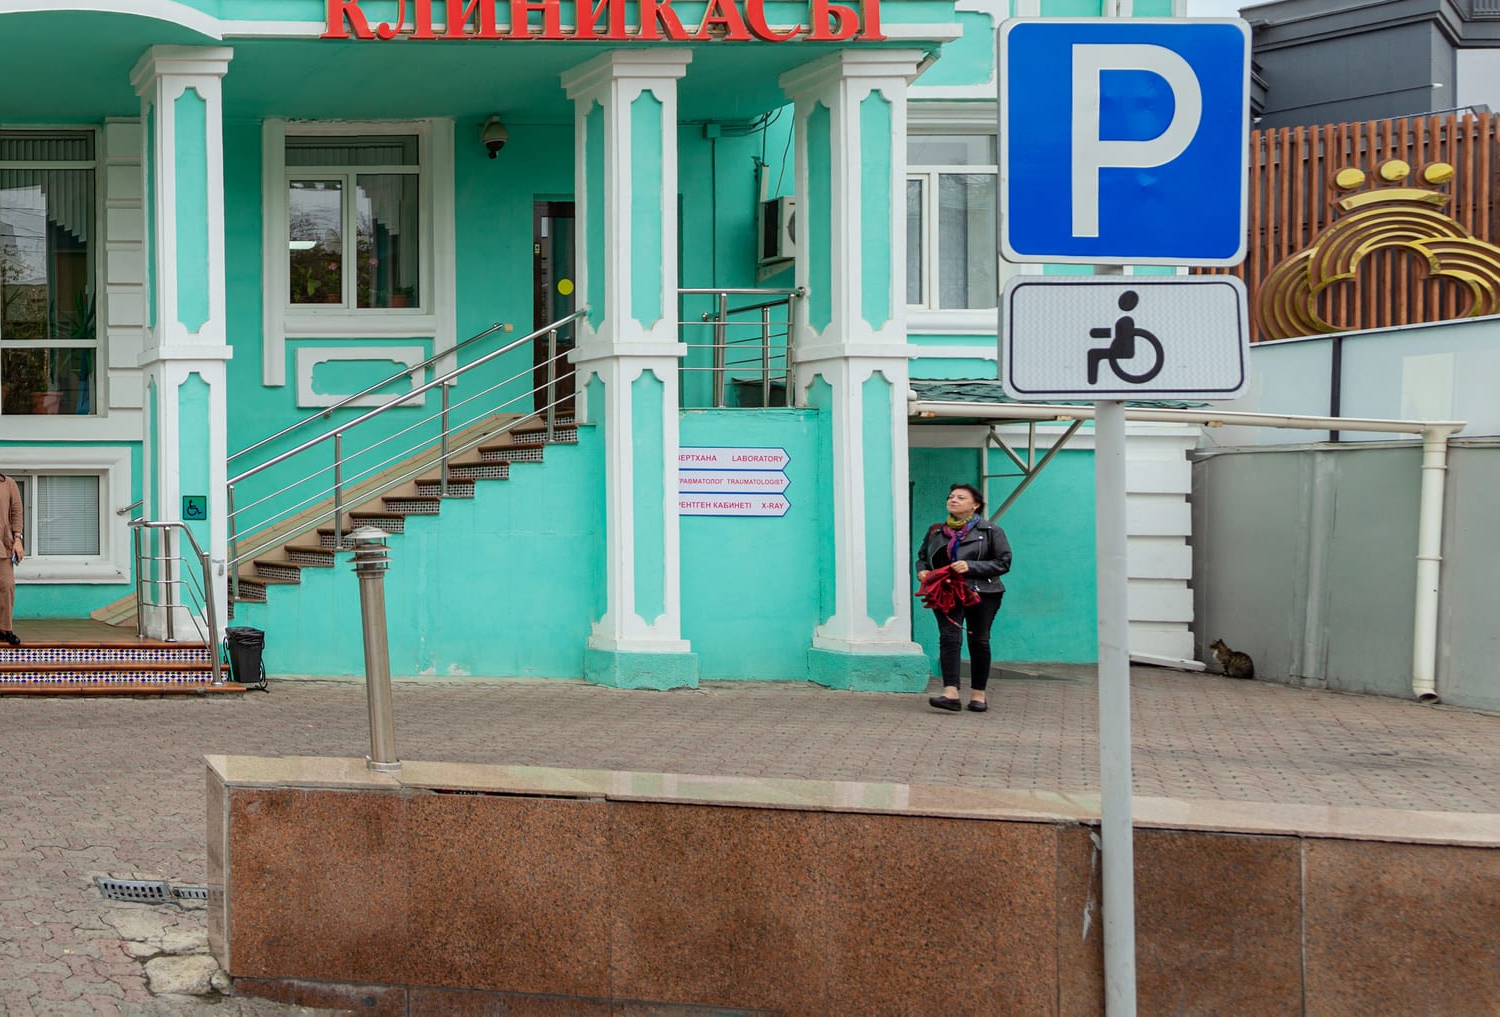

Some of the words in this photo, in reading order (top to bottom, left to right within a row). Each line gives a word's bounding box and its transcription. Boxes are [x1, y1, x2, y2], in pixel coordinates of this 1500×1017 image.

[1072, 43, 1203, 238] P
[731, 455, 784, 463] LABORATORY
[761, 502, 784, 510] X-RAY
